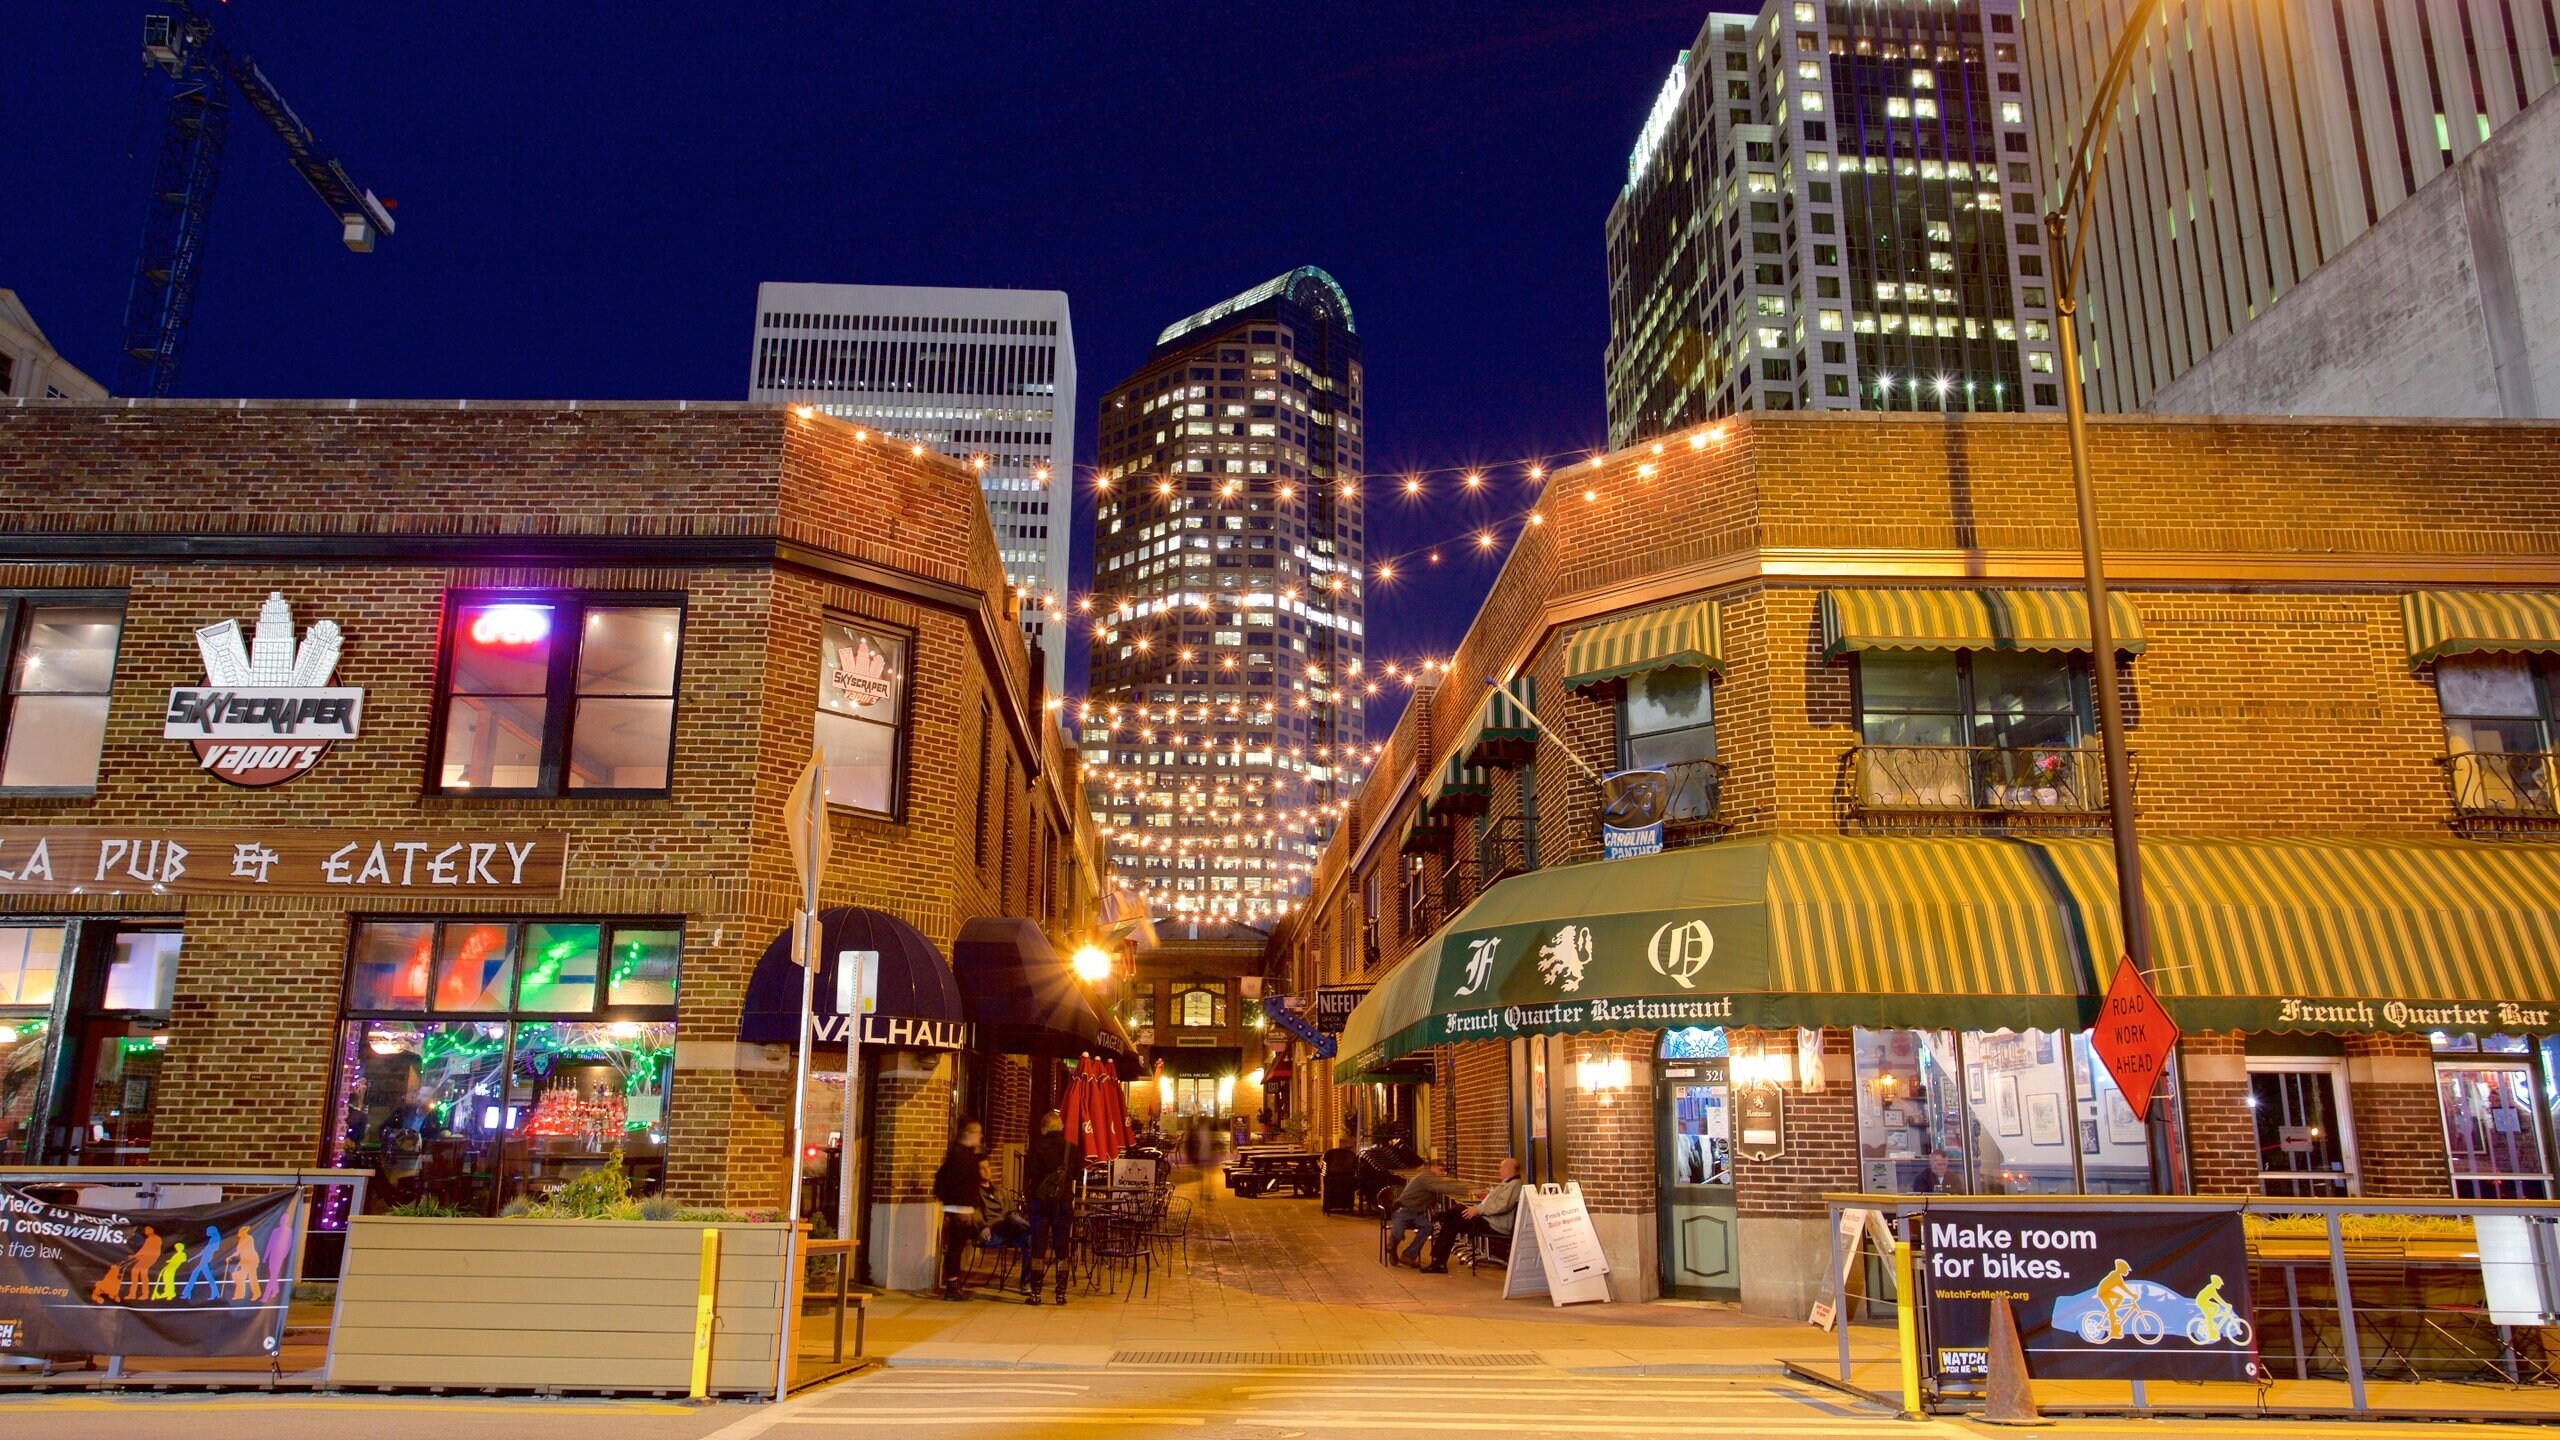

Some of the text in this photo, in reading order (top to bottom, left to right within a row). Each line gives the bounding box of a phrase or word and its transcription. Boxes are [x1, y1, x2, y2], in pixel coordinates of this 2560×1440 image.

[834, 671, 889, 697] SKYSCRAPER
[167, 691, 355, 734] SKYSCRAPER
[1604, 830, 1656, 847] CAROLINA
[94, 839, 190, 883] PUB
[320, 839, 537, 886] EATERY
[1611, 843, 1663, 860] PANTHER
[1454, 919, 1714, 997] F Q
[1445, 996, 1732, 1034] French Quarter Restaurant
[2112, 995, 2144, 1016] ROAD
[2278, 999, 2375, 1028] French
[2383, 1001, 2489, 1026] Quarter
[2498, 1002, 2549, 1026] Bar
[2114, 1024, 2147, 1044] WORK
[1704, 1070, 1724, 1082] 321
[2116, 1054, 2153, 1075] AHEAD
[15, 1218, 128, 1244] crosswalks.
[1931, 1223, 2097, 1250] Make room
[8, 1241, 36, 1258] the
[39, 1242, 63, 1260] law.
[1932, 1252, 2071, 1279] for bikes.
[1941, 1351, 1986, 1366] WATCH
[1945, 1365, 1960, 1374] FOR
